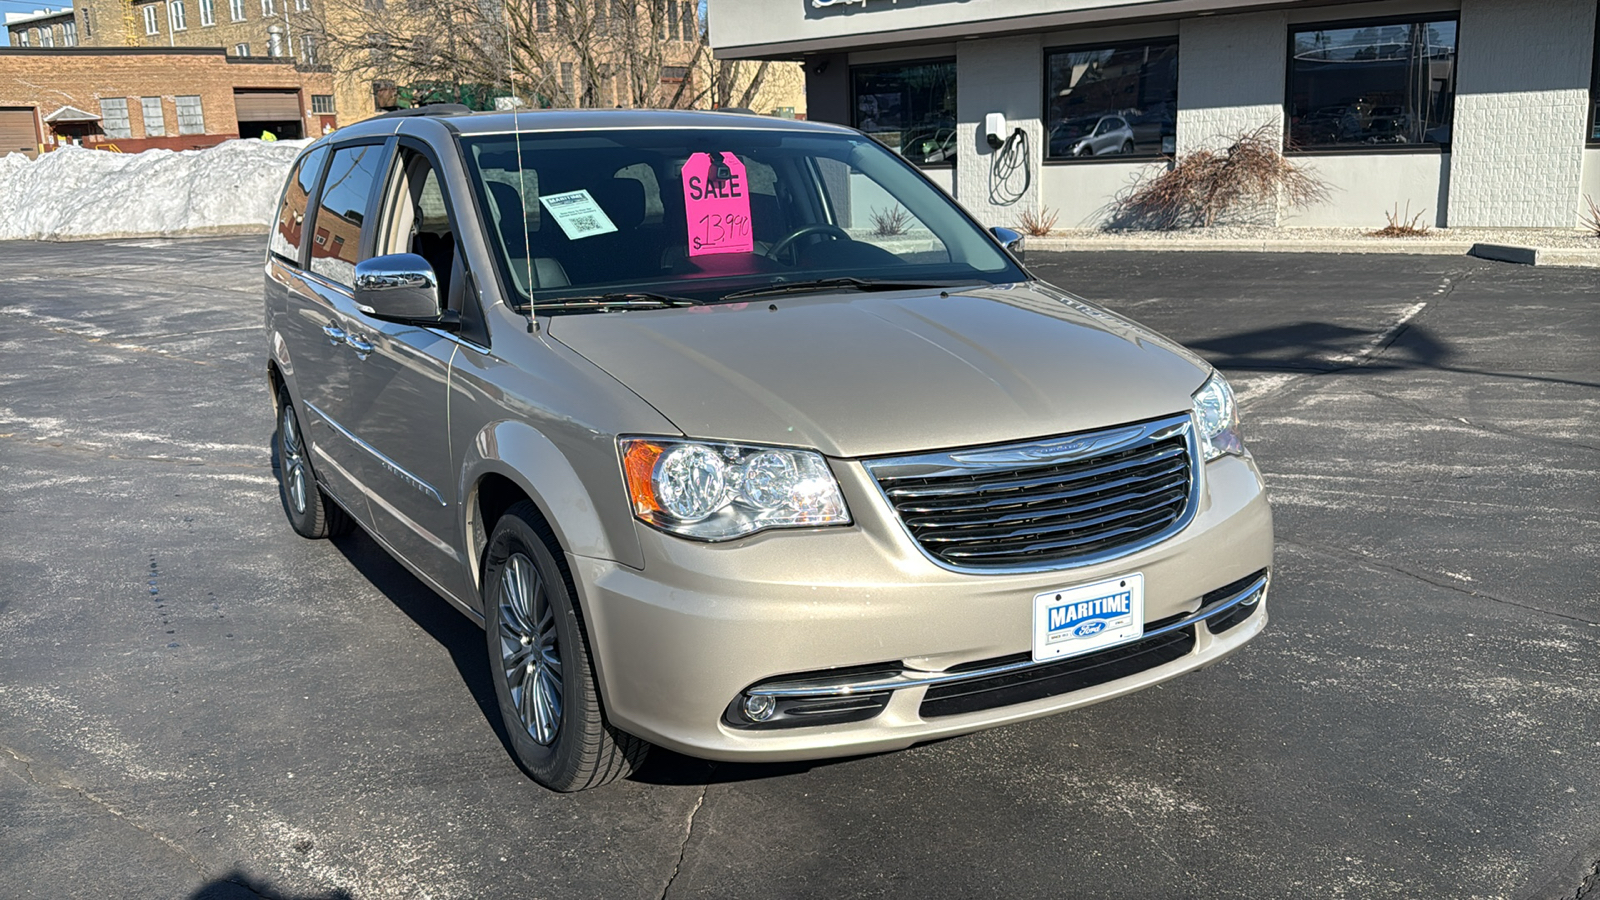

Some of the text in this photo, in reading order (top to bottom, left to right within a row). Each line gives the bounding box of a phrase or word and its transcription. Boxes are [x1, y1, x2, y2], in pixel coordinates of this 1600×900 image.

[689, 175, 741, 200] SALE
[1051, 593, 1129, 630] MARITIME
[1079, 622, 1102, 636] Ford
